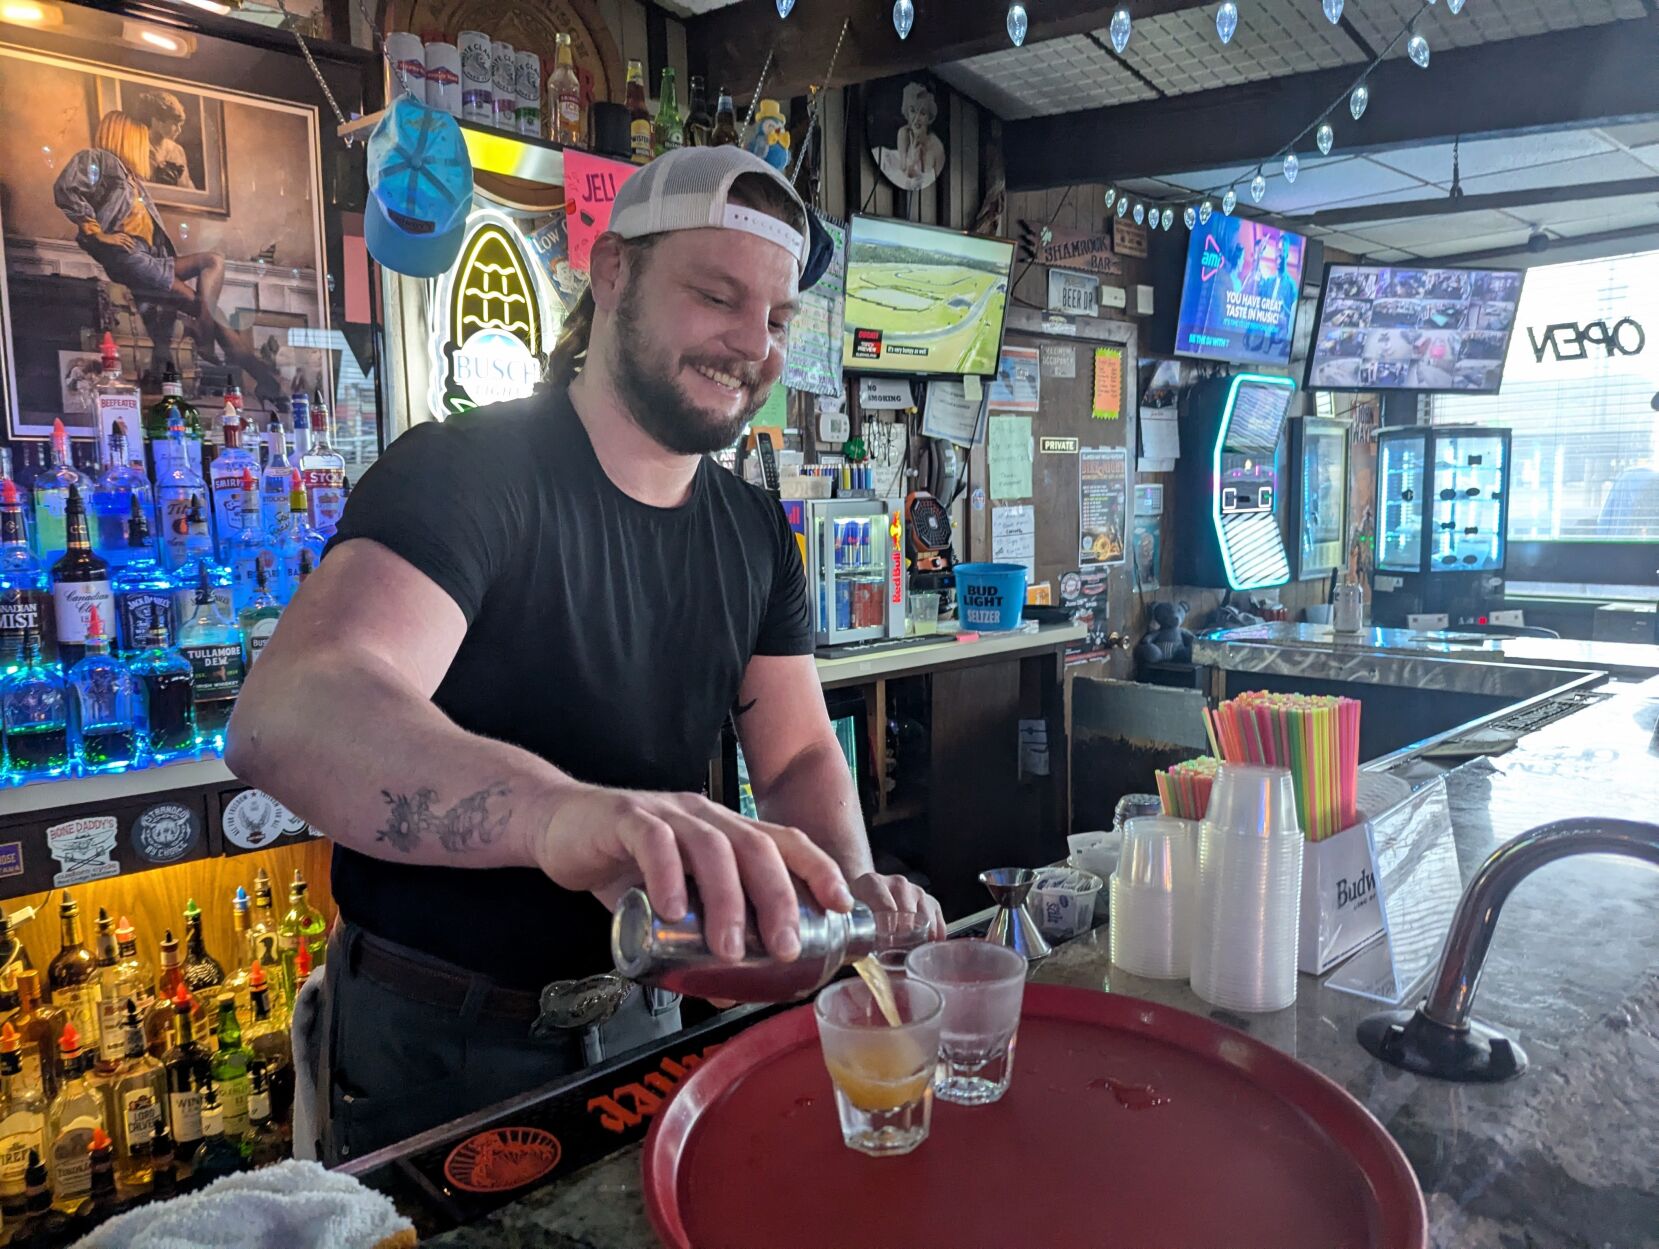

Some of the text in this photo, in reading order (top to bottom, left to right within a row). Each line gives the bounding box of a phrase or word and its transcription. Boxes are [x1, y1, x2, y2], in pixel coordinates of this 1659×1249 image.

[1045, 236, 1108, 261] SHAMROCK
[1091, 255, 1111, 271] BAR
[1062, 288, 1082, 309] BEER
[1226, 290, 1283, 312] YOU HAVE GREAT
[1226, 304, 1248, 319] TASTE
[1248, 307, 1256, 320] IN
[456, 354, 540, 385] BUSCH
[101, 399, 138, 409] BEEFEATER
[1044, 441, 1075, 450] PRIVATE
[967, 585, 998, 596] BUD
[963, 595, 1004, 607] LIGHT
[967, 609, 1000, 624] SELTZER
[187, 646, 241, 659] TULLAMORE
[50, 819, 114, 840] BONE DADDY'S
